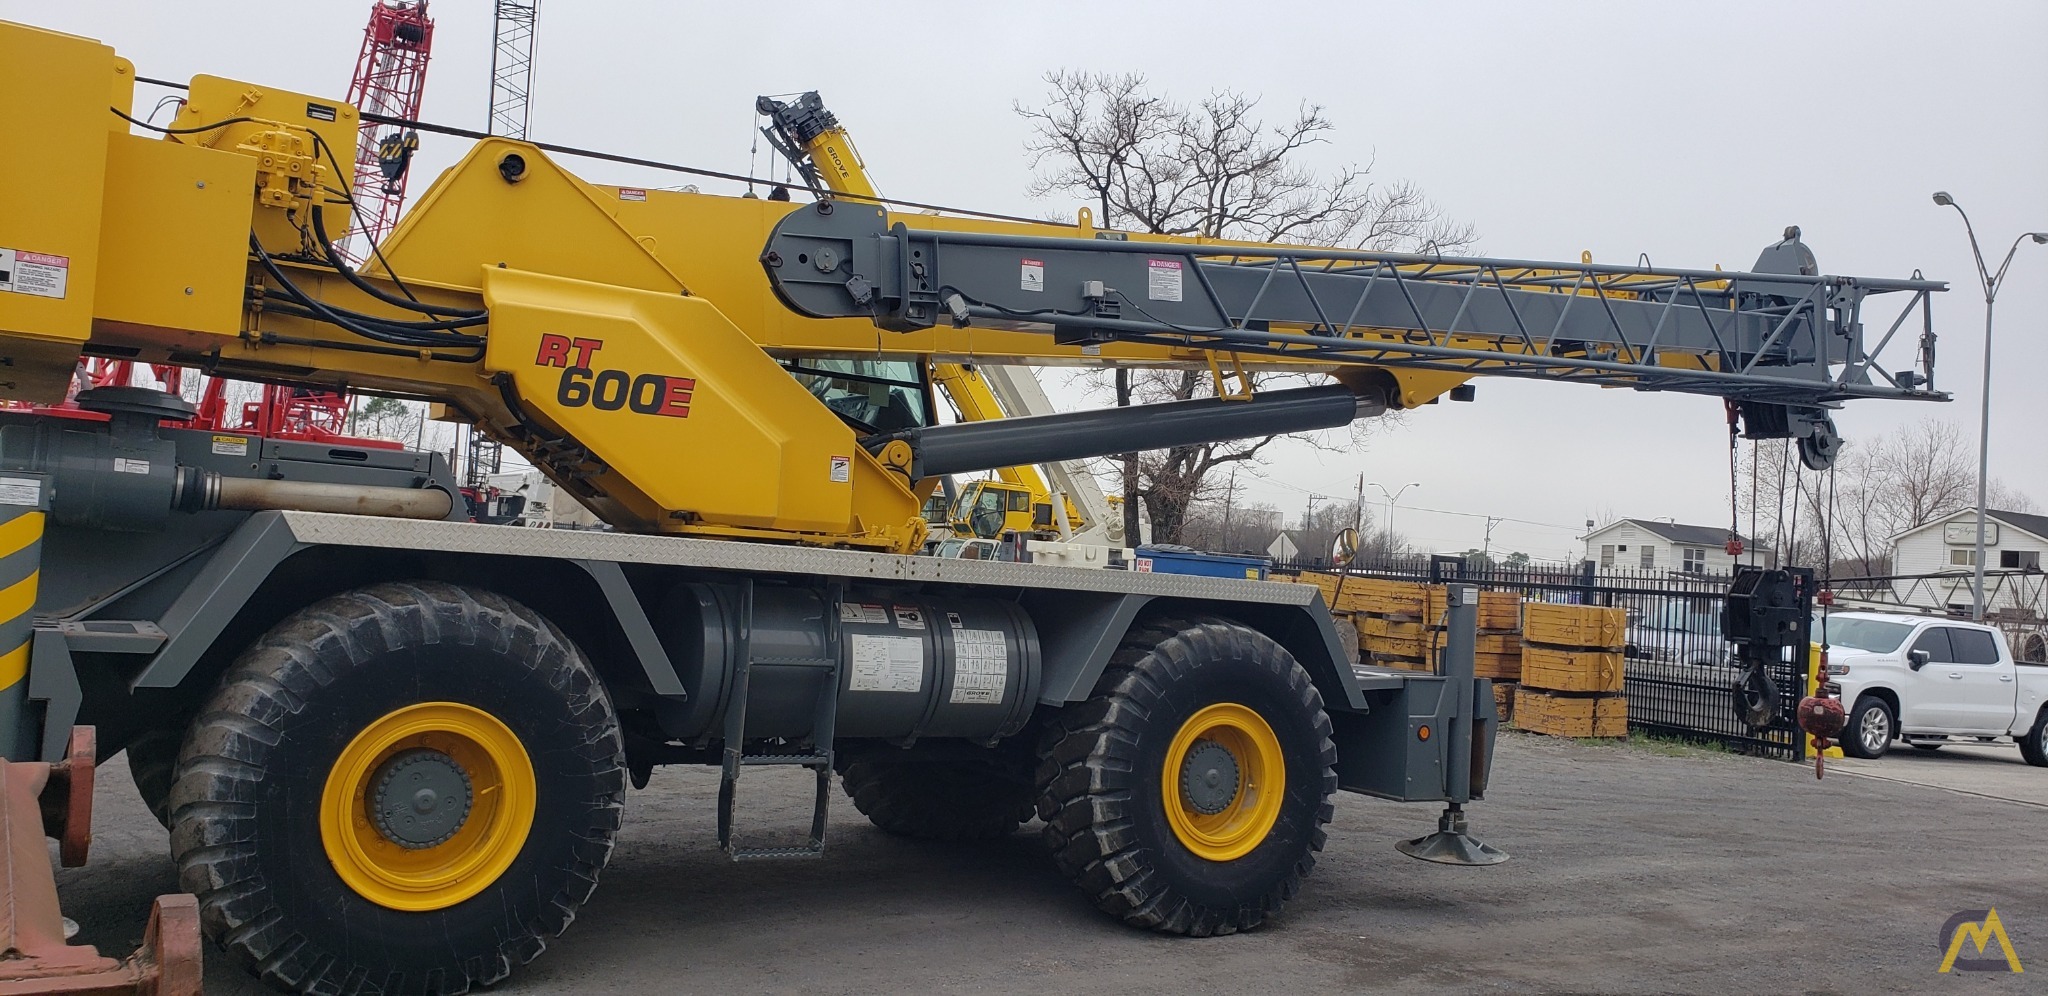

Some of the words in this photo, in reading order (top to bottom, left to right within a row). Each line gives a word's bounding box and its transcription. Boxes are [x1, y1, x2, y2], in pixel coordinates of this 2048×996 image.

[827, 146, 850, 179] GROVE
[31, 255, 62, 265] DANGER
[1156, 261, 1180, 269] DANGER
[534, 332, 604, 369] RT
[556, 365, 697, 419] 600E
